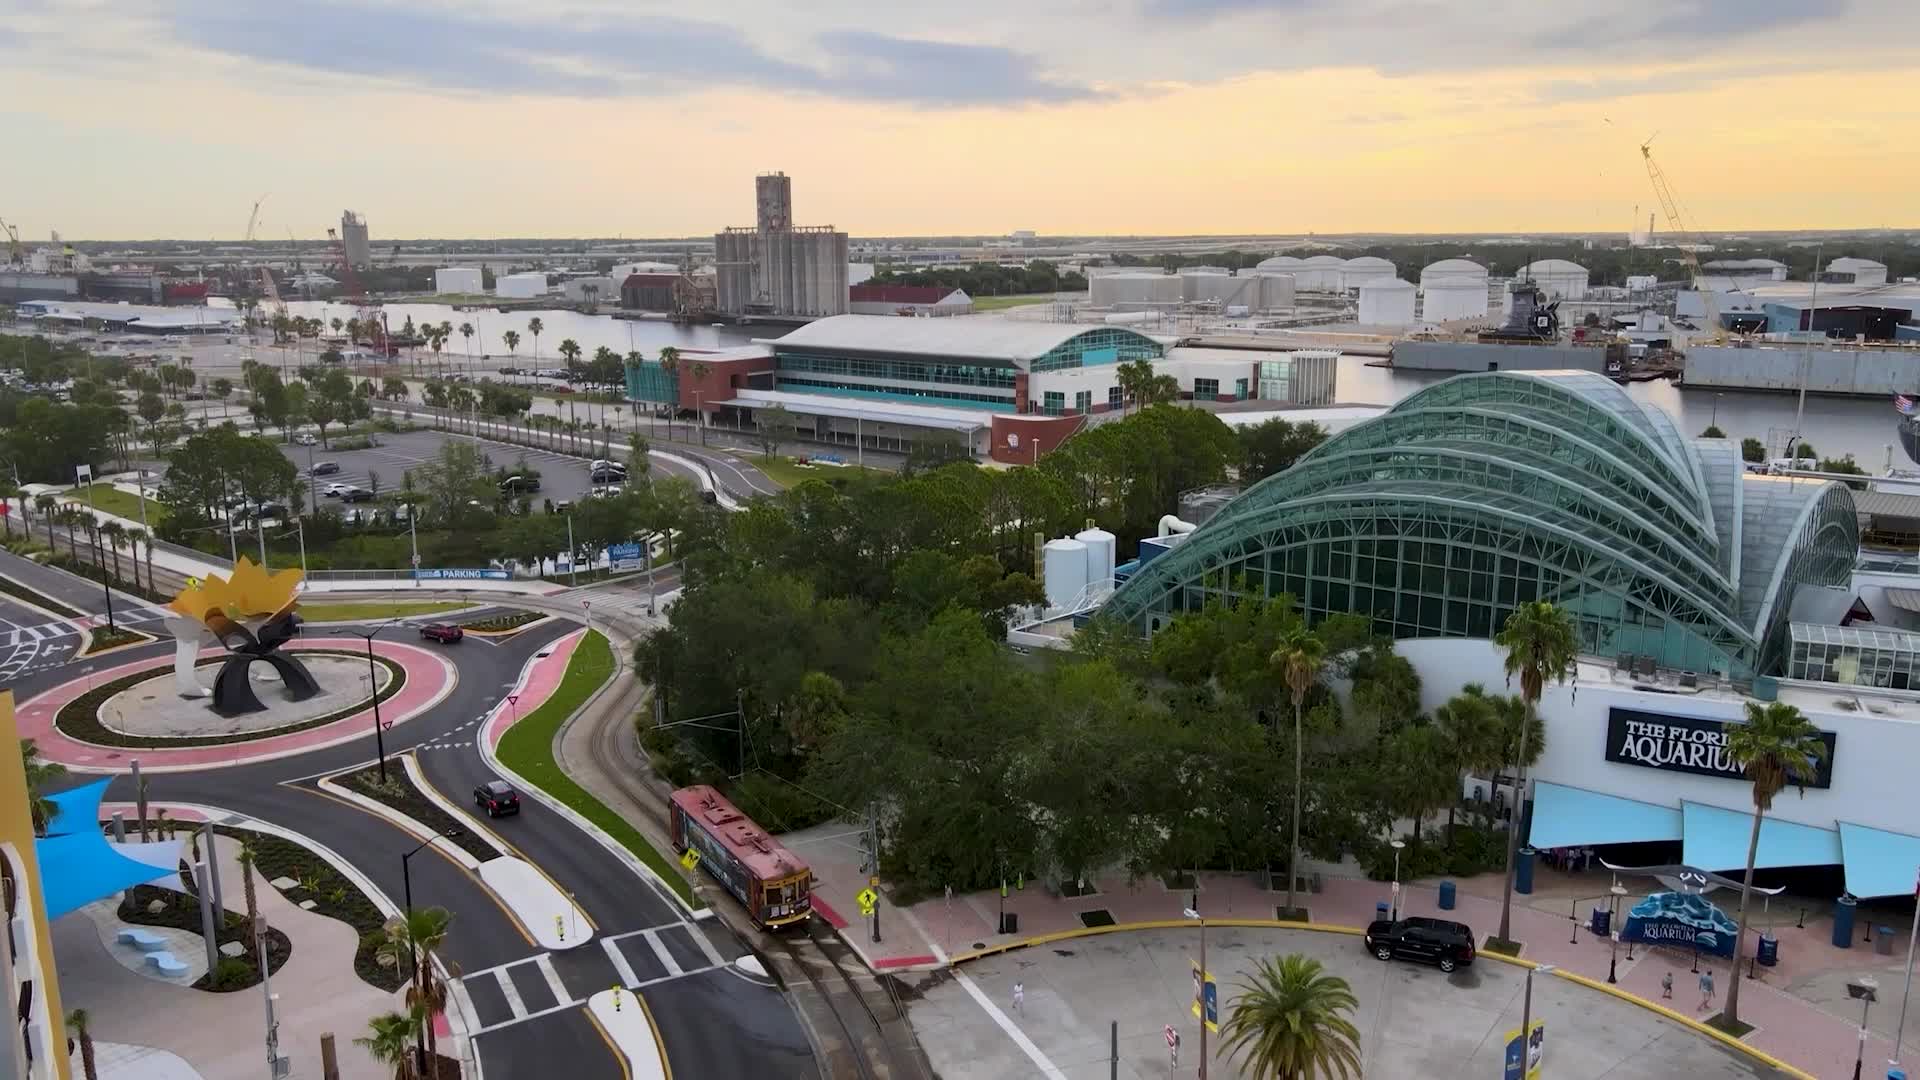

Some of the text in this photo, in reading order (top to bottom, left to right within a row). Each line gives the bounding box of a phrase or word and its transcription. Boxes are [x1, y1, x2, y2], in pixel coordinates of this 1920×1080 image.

[443, 570, 481, 578] PARKING
[1626, 720, 1730, 746] THE FLORI
[1643, 927, 1696, 942] AQUARIUM
